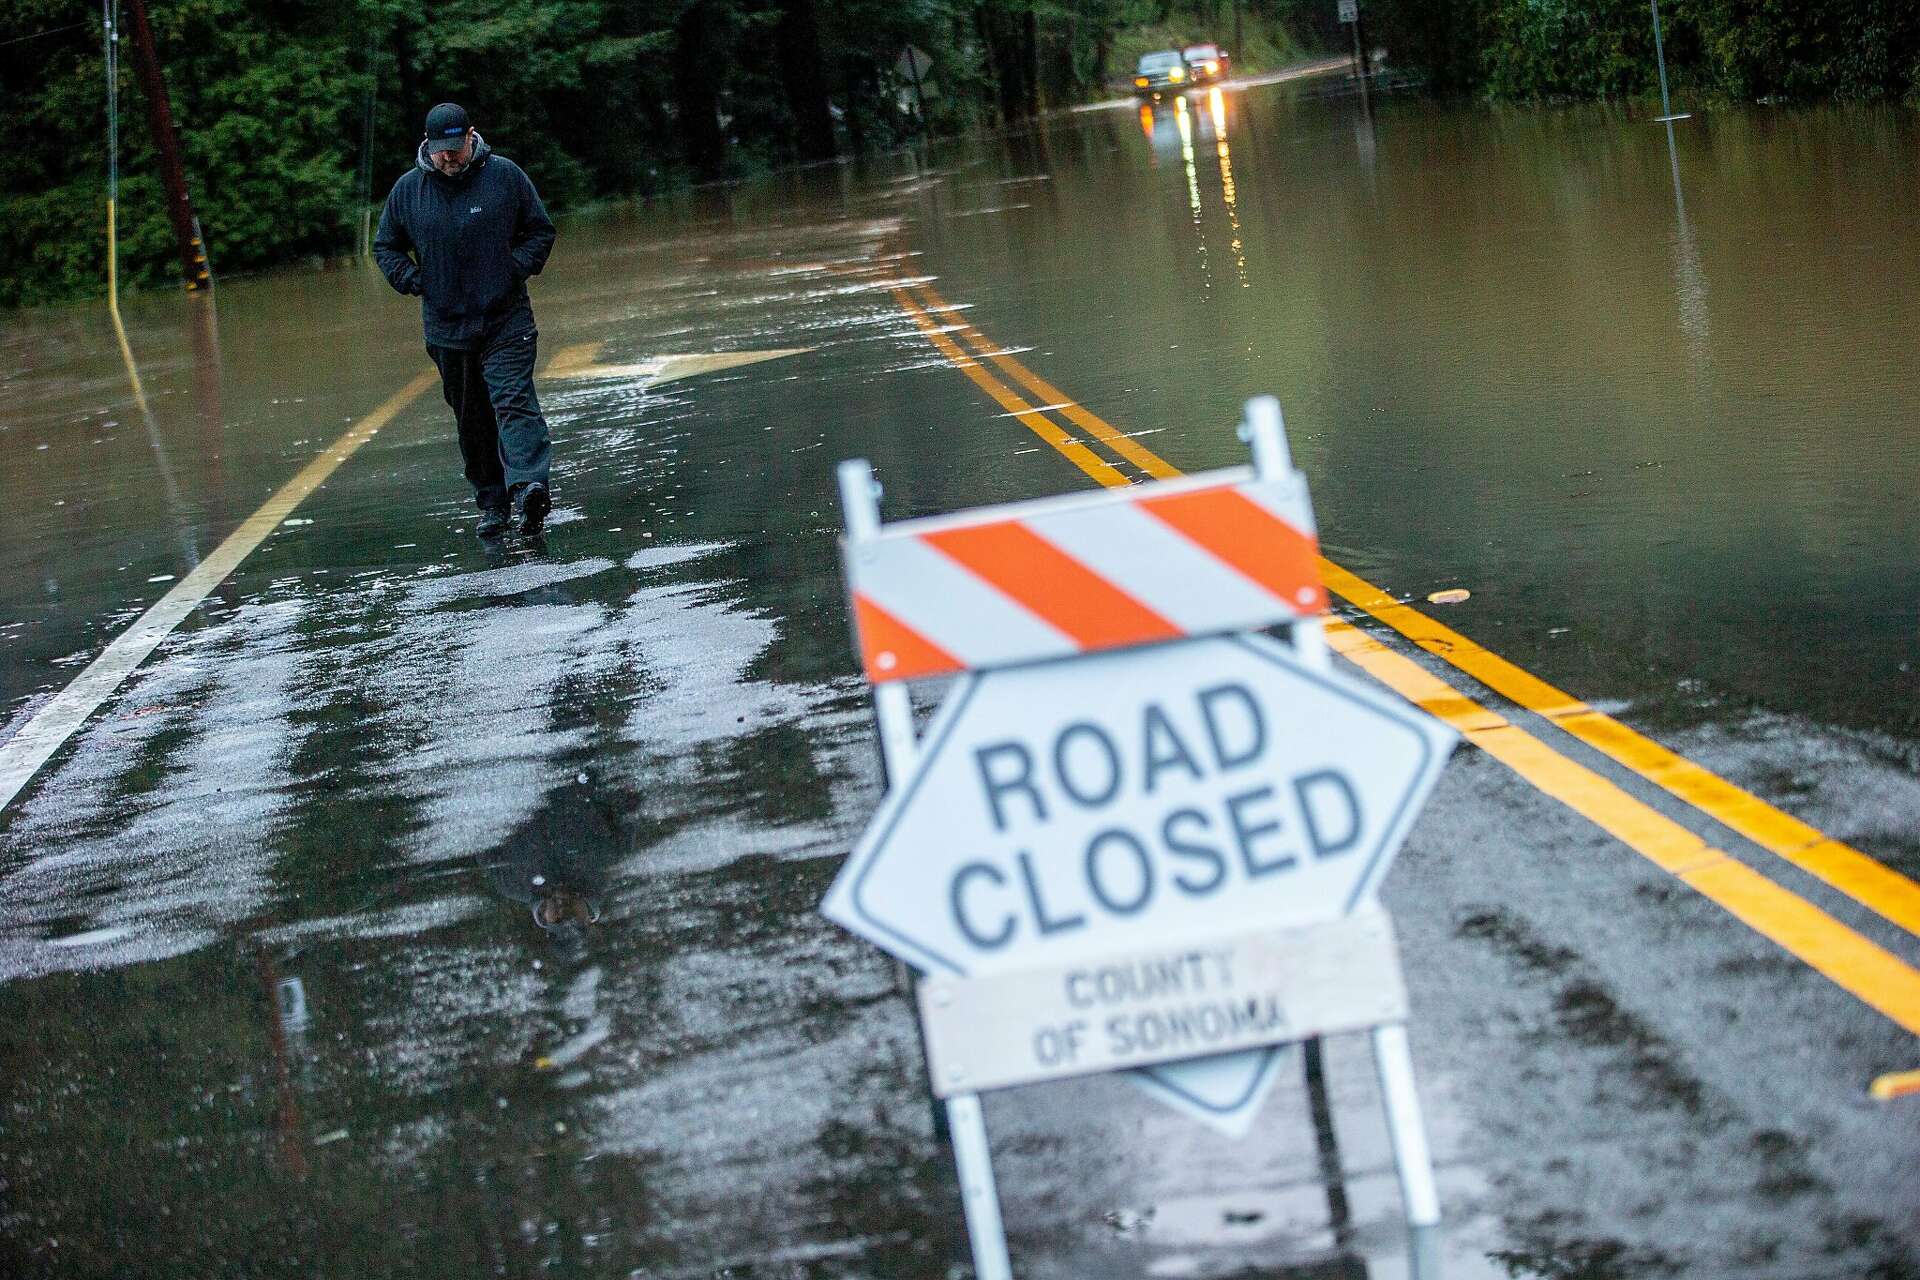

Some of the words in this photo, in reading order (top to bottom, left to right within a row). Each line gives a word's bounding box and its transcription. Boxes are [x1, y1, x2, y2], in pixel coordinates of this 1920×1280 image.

[975, 682, 1269, 831] ROAD
[949, 769, 1363, 951] CLOSED
[1033, 1020, 1087, 1066] OF
[1105, 994, 1285, 1056] SONOMA
[1065, 951, 1236, 1008] COUNTY
